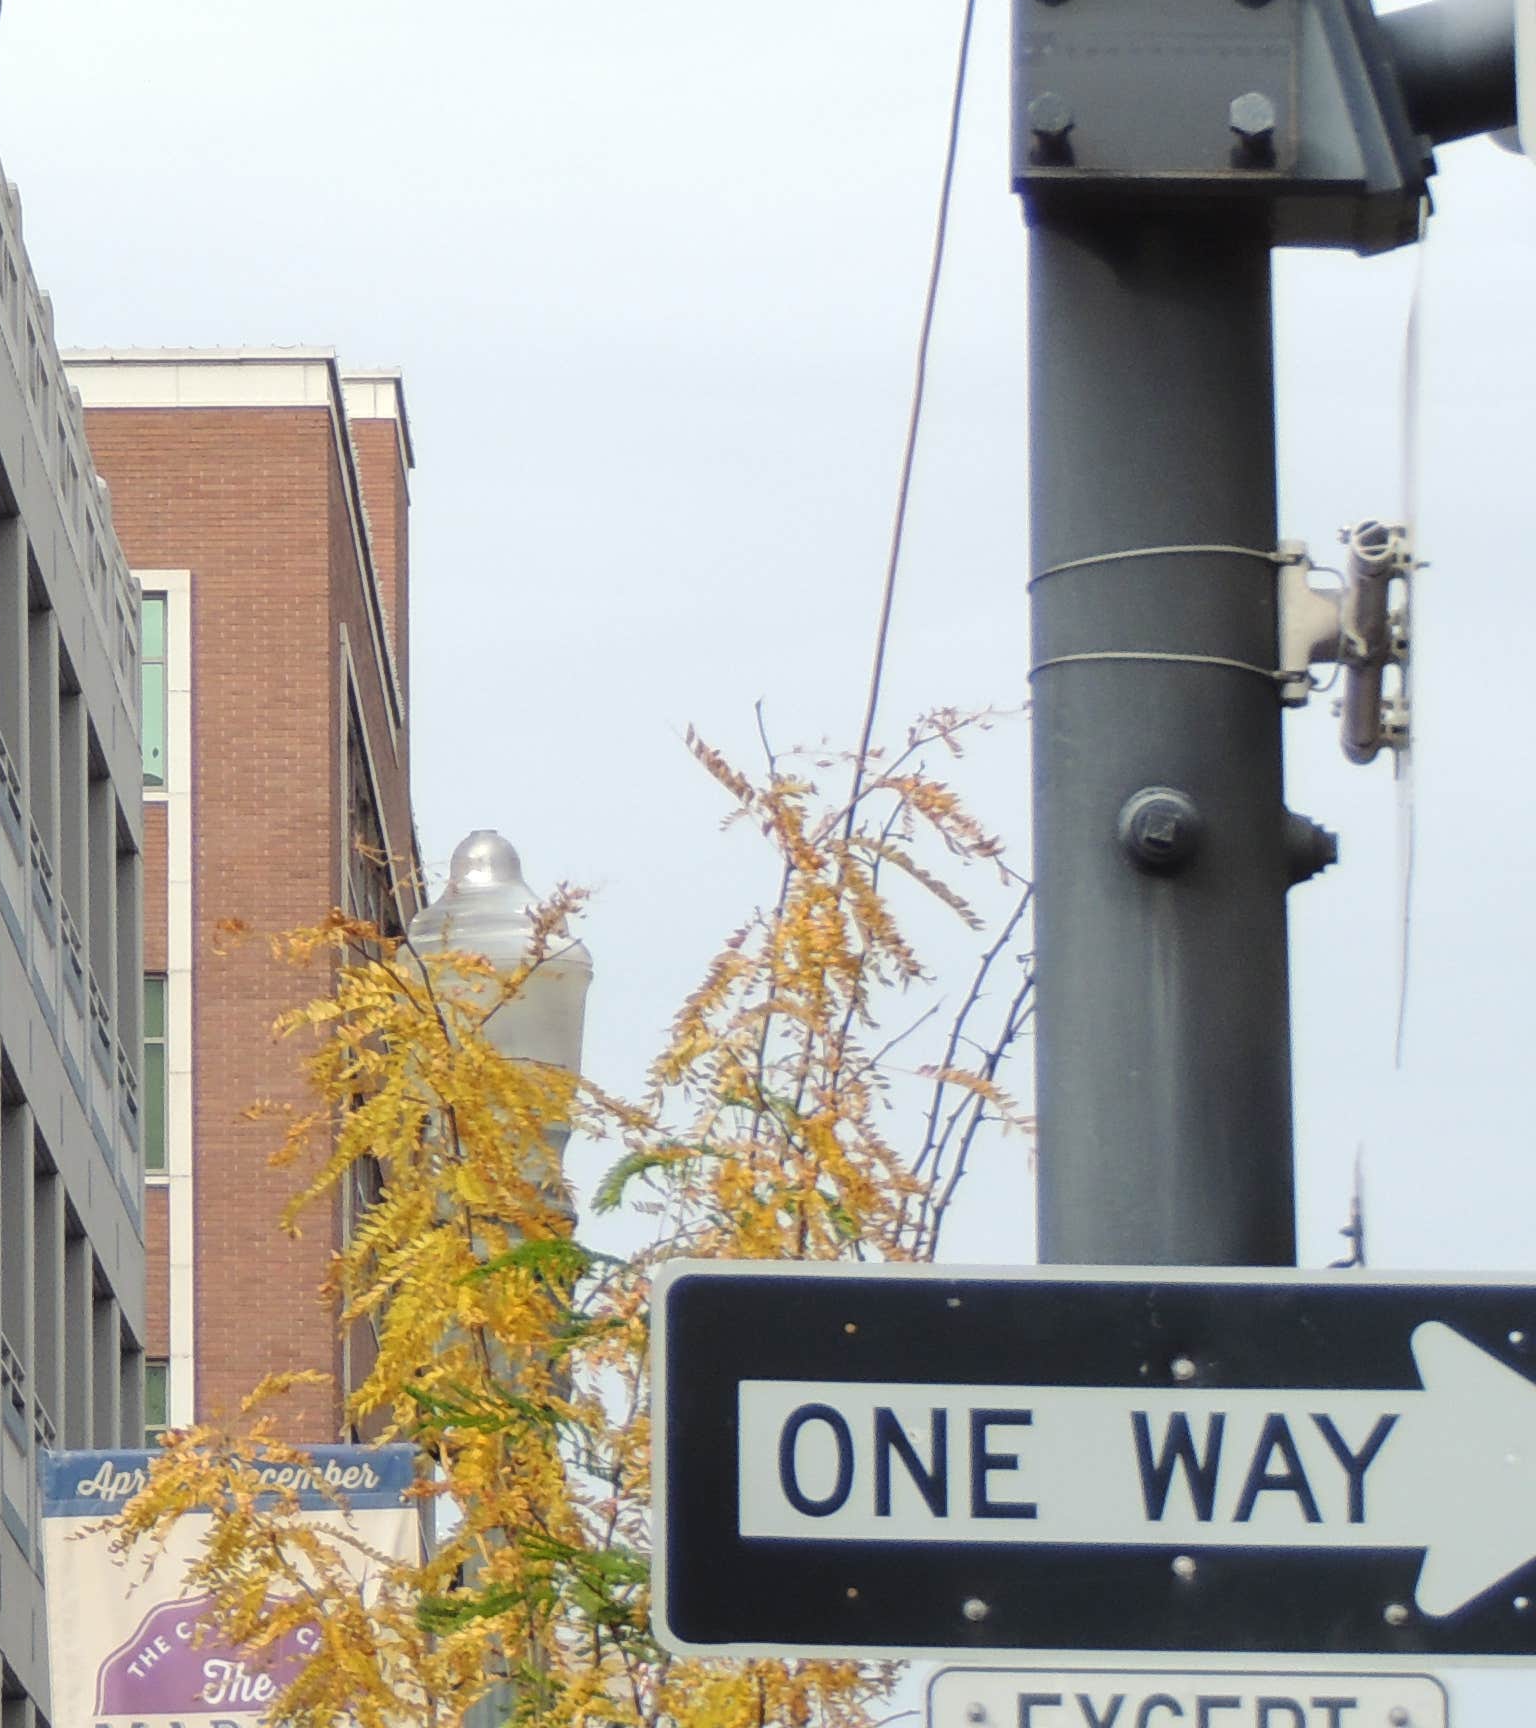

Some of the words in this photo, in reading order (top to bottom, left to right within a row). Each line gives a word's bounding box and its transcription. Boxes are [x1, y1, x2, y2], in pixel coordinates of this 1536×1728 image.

[77, 1459, 156, 1502] Apr
[778, 1403, 1039, 1517] ONE
[1131, 1411, 1399, 1523] WAY
[127, 1635, 172, 1678] THE
[202, 1658, 277, 1705] The
